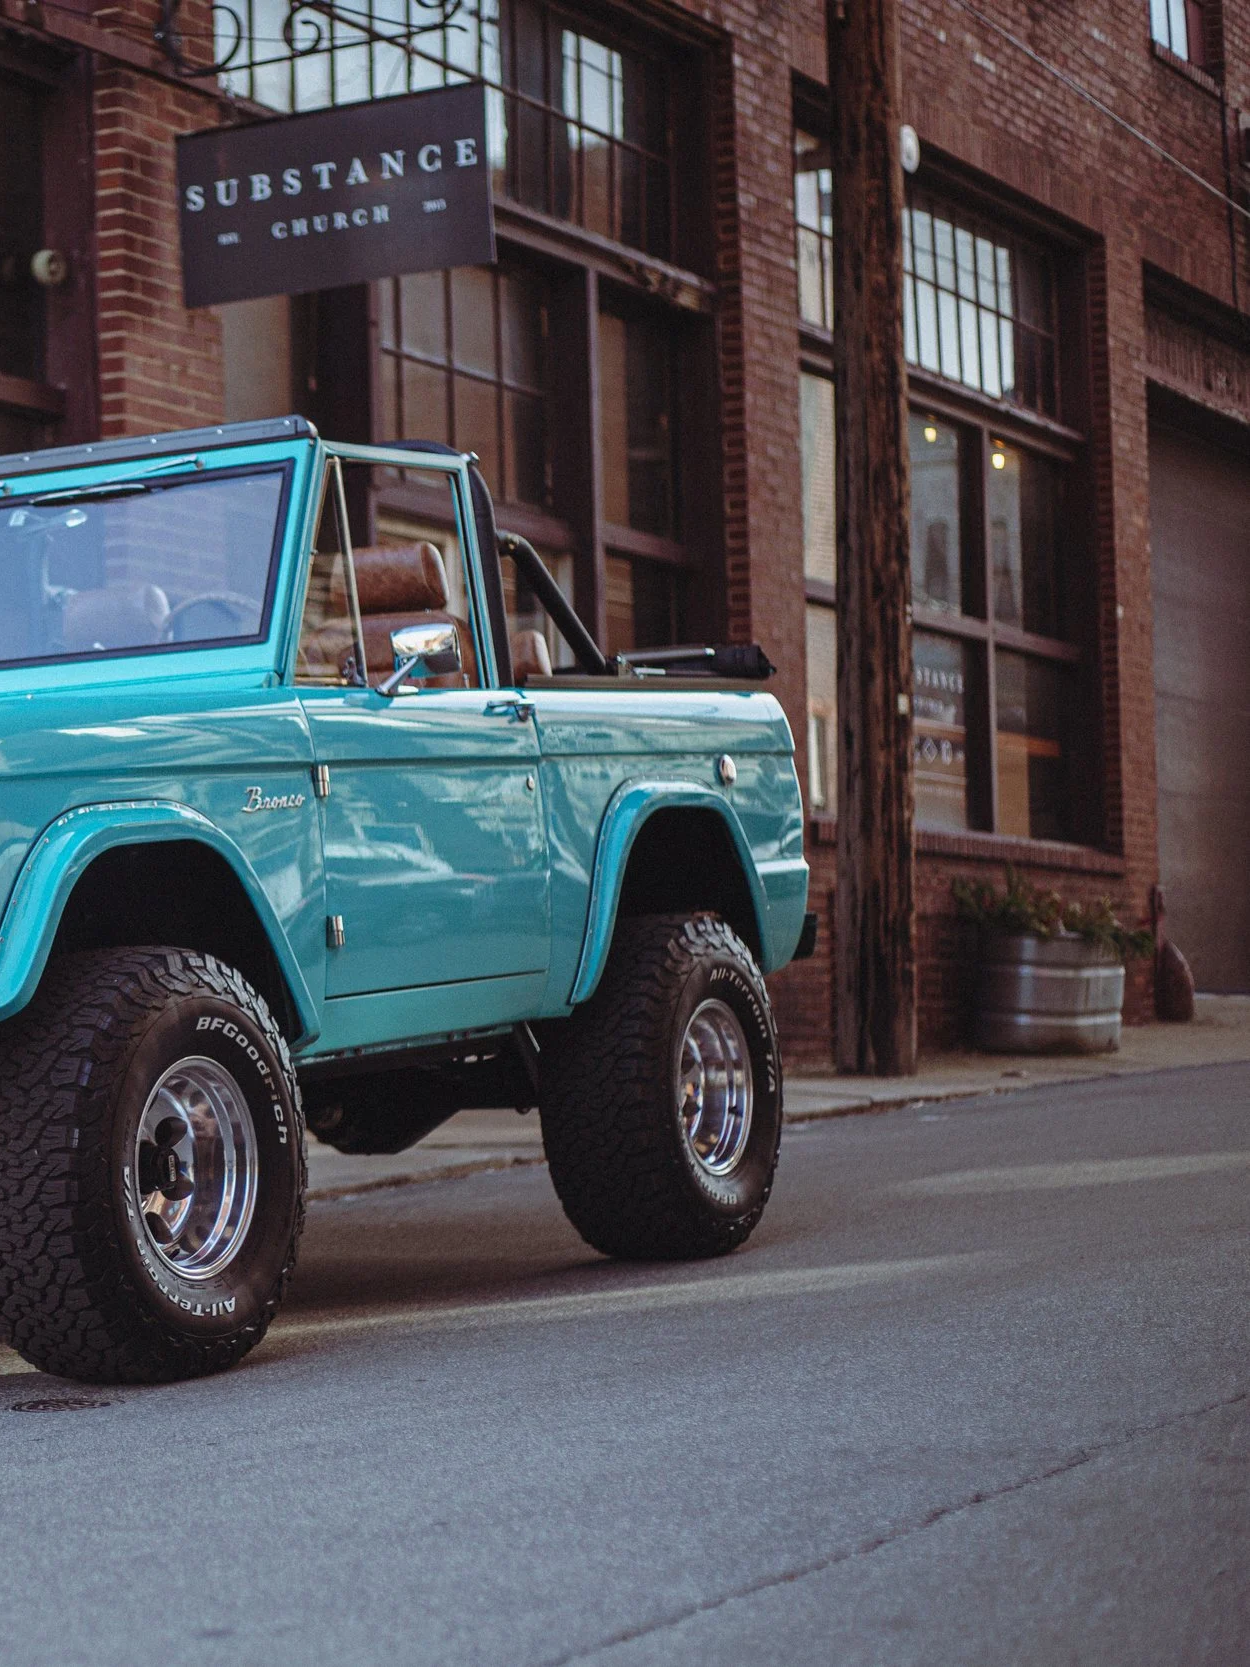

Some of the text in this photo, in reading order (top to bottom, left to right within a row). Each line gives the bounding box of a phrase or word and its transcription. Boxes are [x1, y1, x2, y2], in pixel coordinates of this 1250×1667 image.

[186, 138, 478, 212] SUBSTANCE
[271, 204, 390, 239] CHURCH
[241, 786, 305, 812] Bronco
[196, 1017, 287, 1143] BFGoodrich
[137, 1239, 235, 1316] All-Terrain
